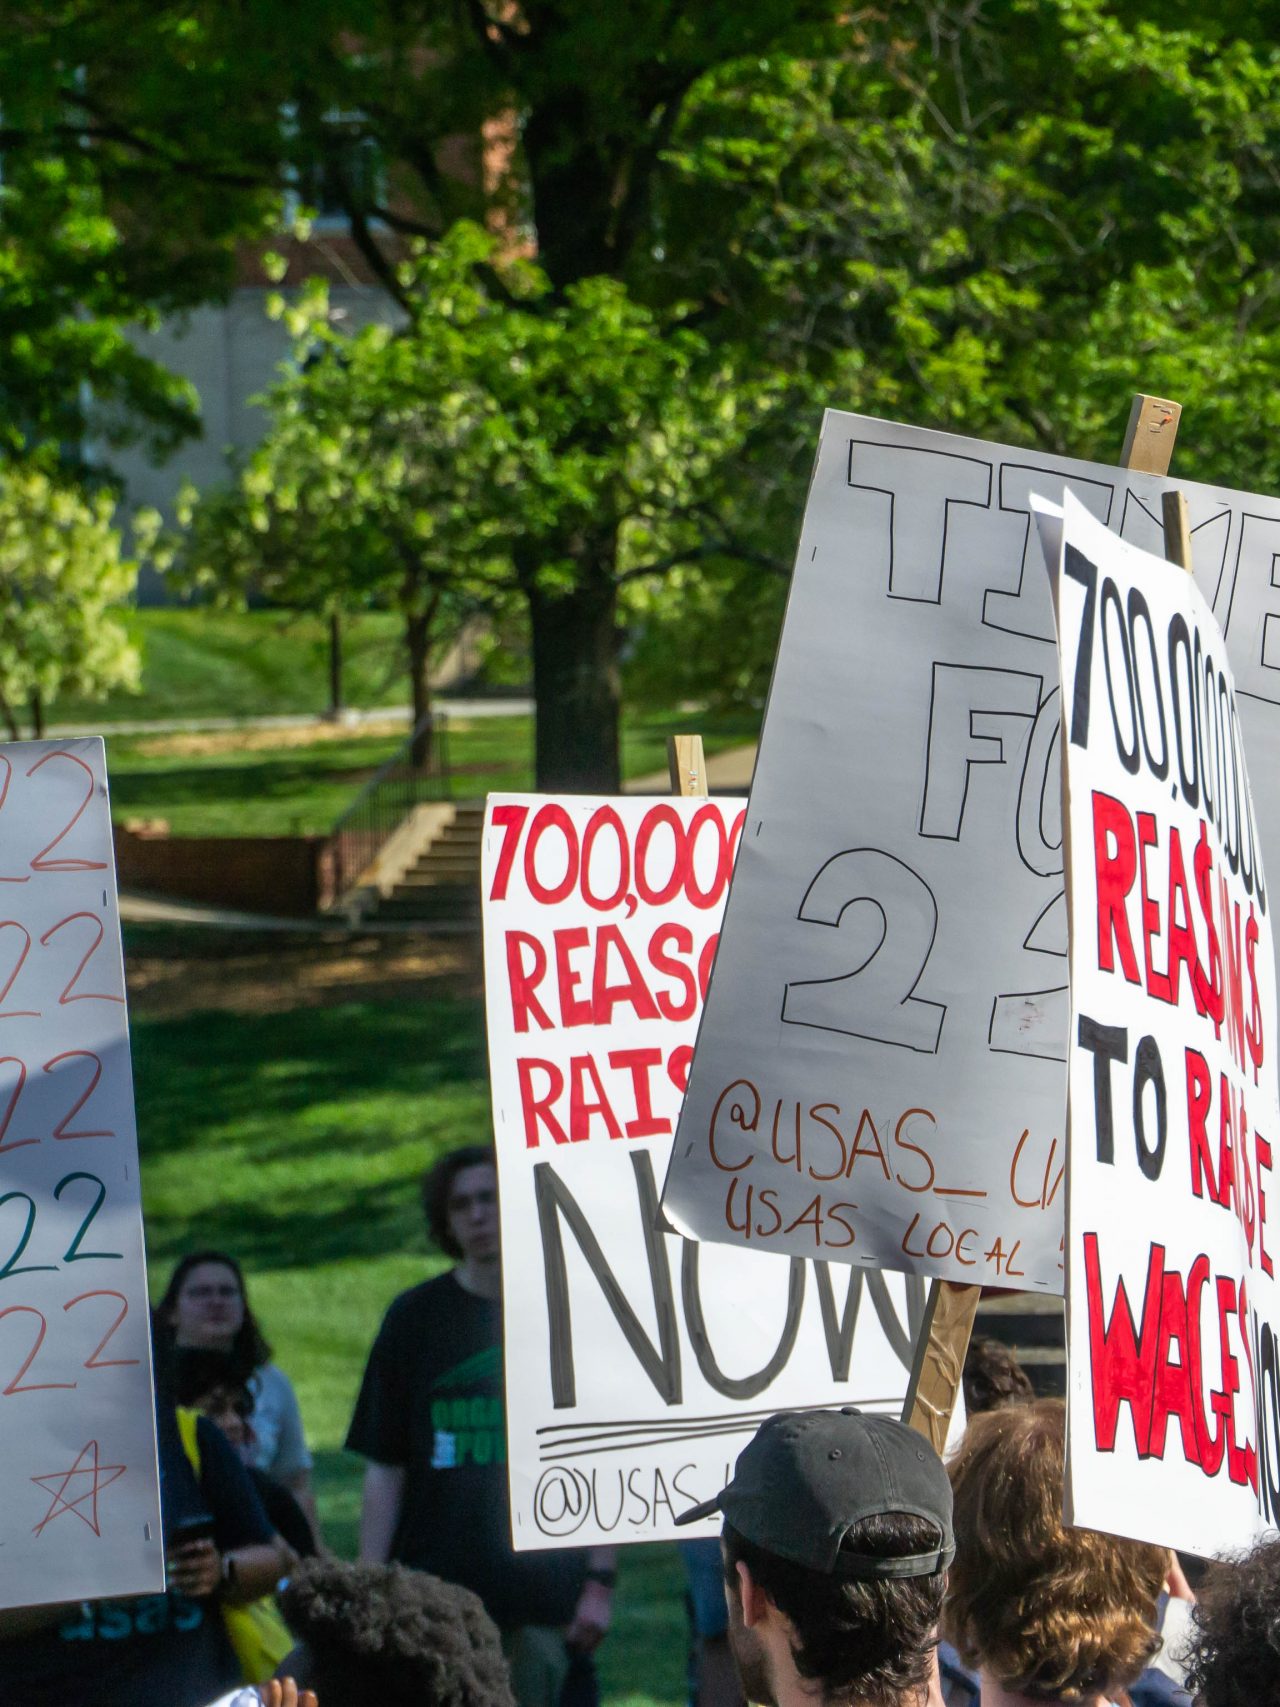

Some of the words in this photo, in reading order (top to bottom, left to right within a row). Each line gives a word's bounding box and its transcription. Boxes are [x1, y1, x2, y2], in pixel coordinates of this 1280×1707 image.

[489, 803, 748, 919] 700,00
[505, 922, 721, 1034] REAS
[1078, 1014, 1168, 1181] TO
[724, 1176, 858, 1248] USAS
[901, 1212, 1025, 1276] LOCAL
[534, 1463, 730, 1538] @USAS_
